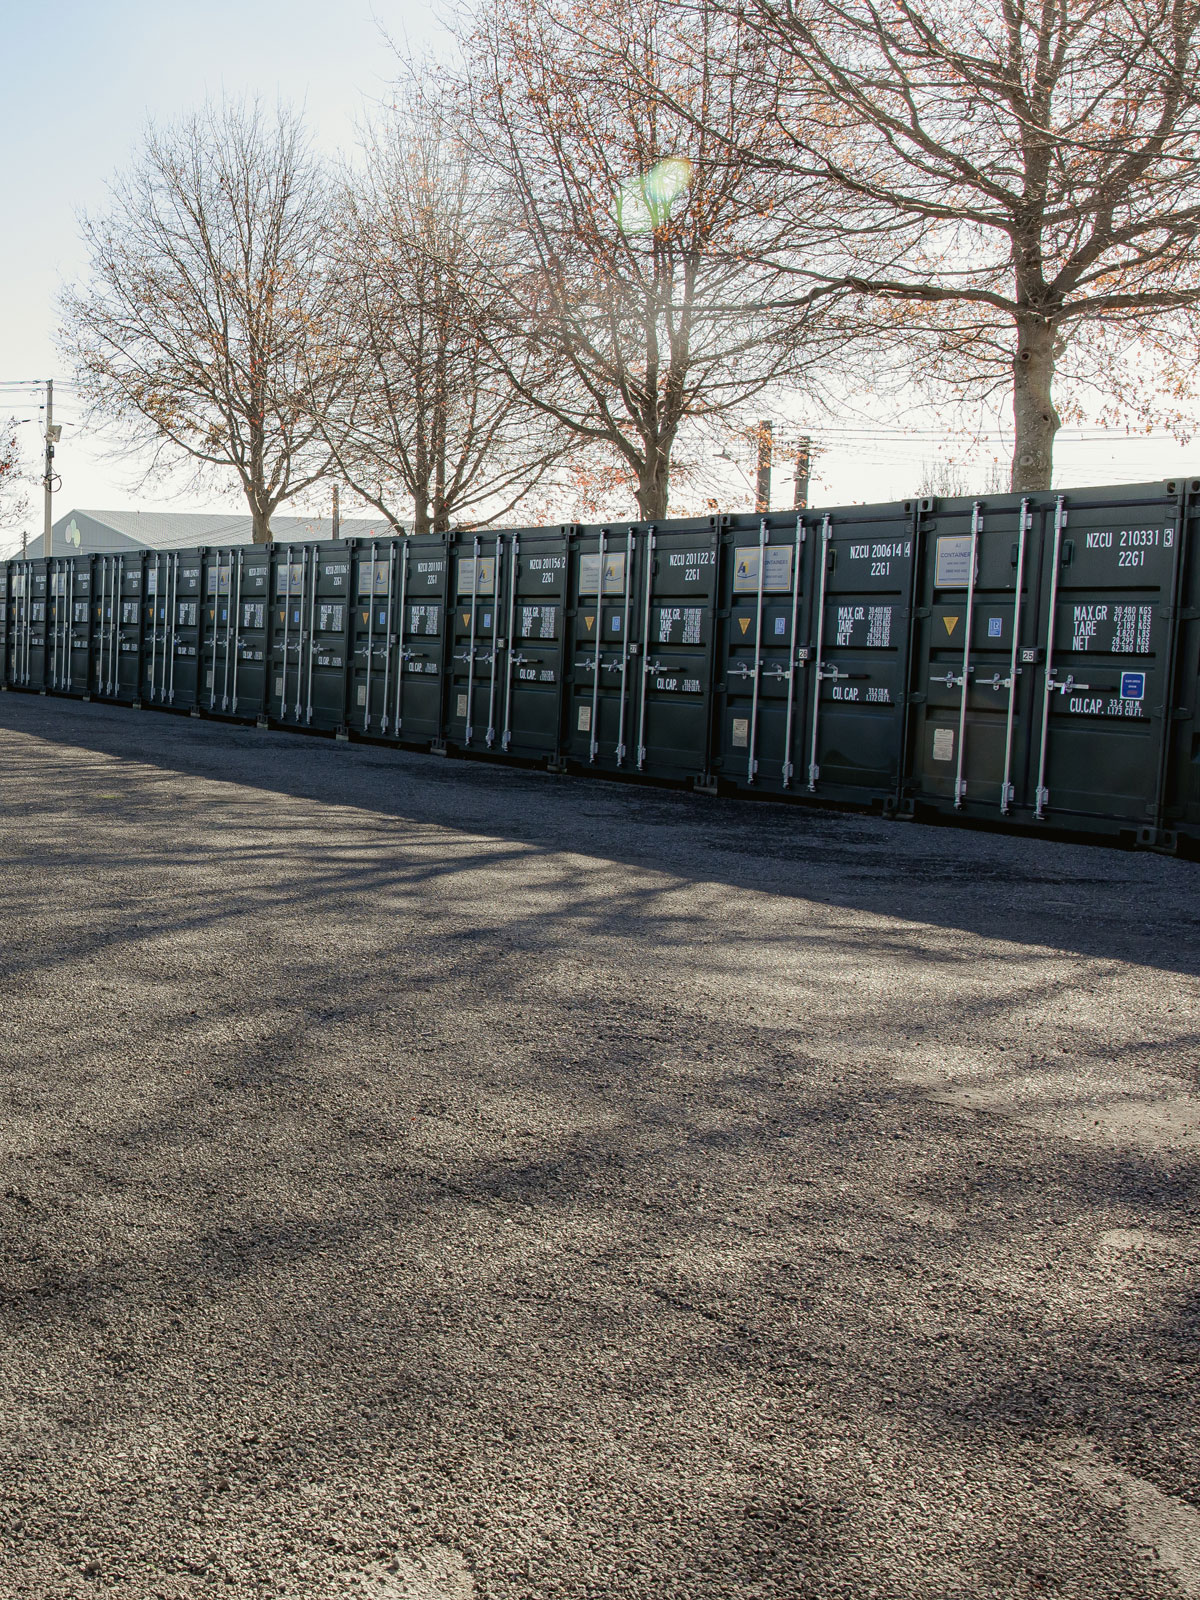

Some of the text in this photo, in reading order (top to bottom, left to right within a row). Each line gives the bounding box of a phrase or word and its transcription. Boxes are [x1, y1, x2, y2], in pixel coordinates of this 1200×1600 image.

[1086, 529, 1173, 548] NZCU 210331 3
[850, 545, 869, 559] NZCU
[872, 543, 902, 558] 200614
[670, 554, 685, 566] NZCU
[686, 553, 709, 565] 201122
[1118, 550, 1144, 567] 22G1
[530, 560, 541, 570] NZCU
[871, 563, 890, 576] 22G1
[684, 570, 700, 581] 22G1
[1114, 606, 1137, 614] 30.480
[1139, 606, 1152, 615] KGS
[1113, 614, 1152, 622] 67.200 LBS
[660, 620, 672, 631] TARE
[838, 620, 854, 633] TARE
[1074, 621, 1151, 636] TARE 2.185 KGS
[659, 631, 670, 643] NET
[836, 633, 850, 646] NET
[1137, 630, 1150, 638] LBS
[1072, 636, 1089, 651] NET
[1136, 637, 1150, 645] KGS
[1136, 645, 1149, 653] LBS
[1024, 652, 1033, 660] 25
[1109, 699, 1123, 708] 33.2
[1107, 707, 1122, 716] 1.173
